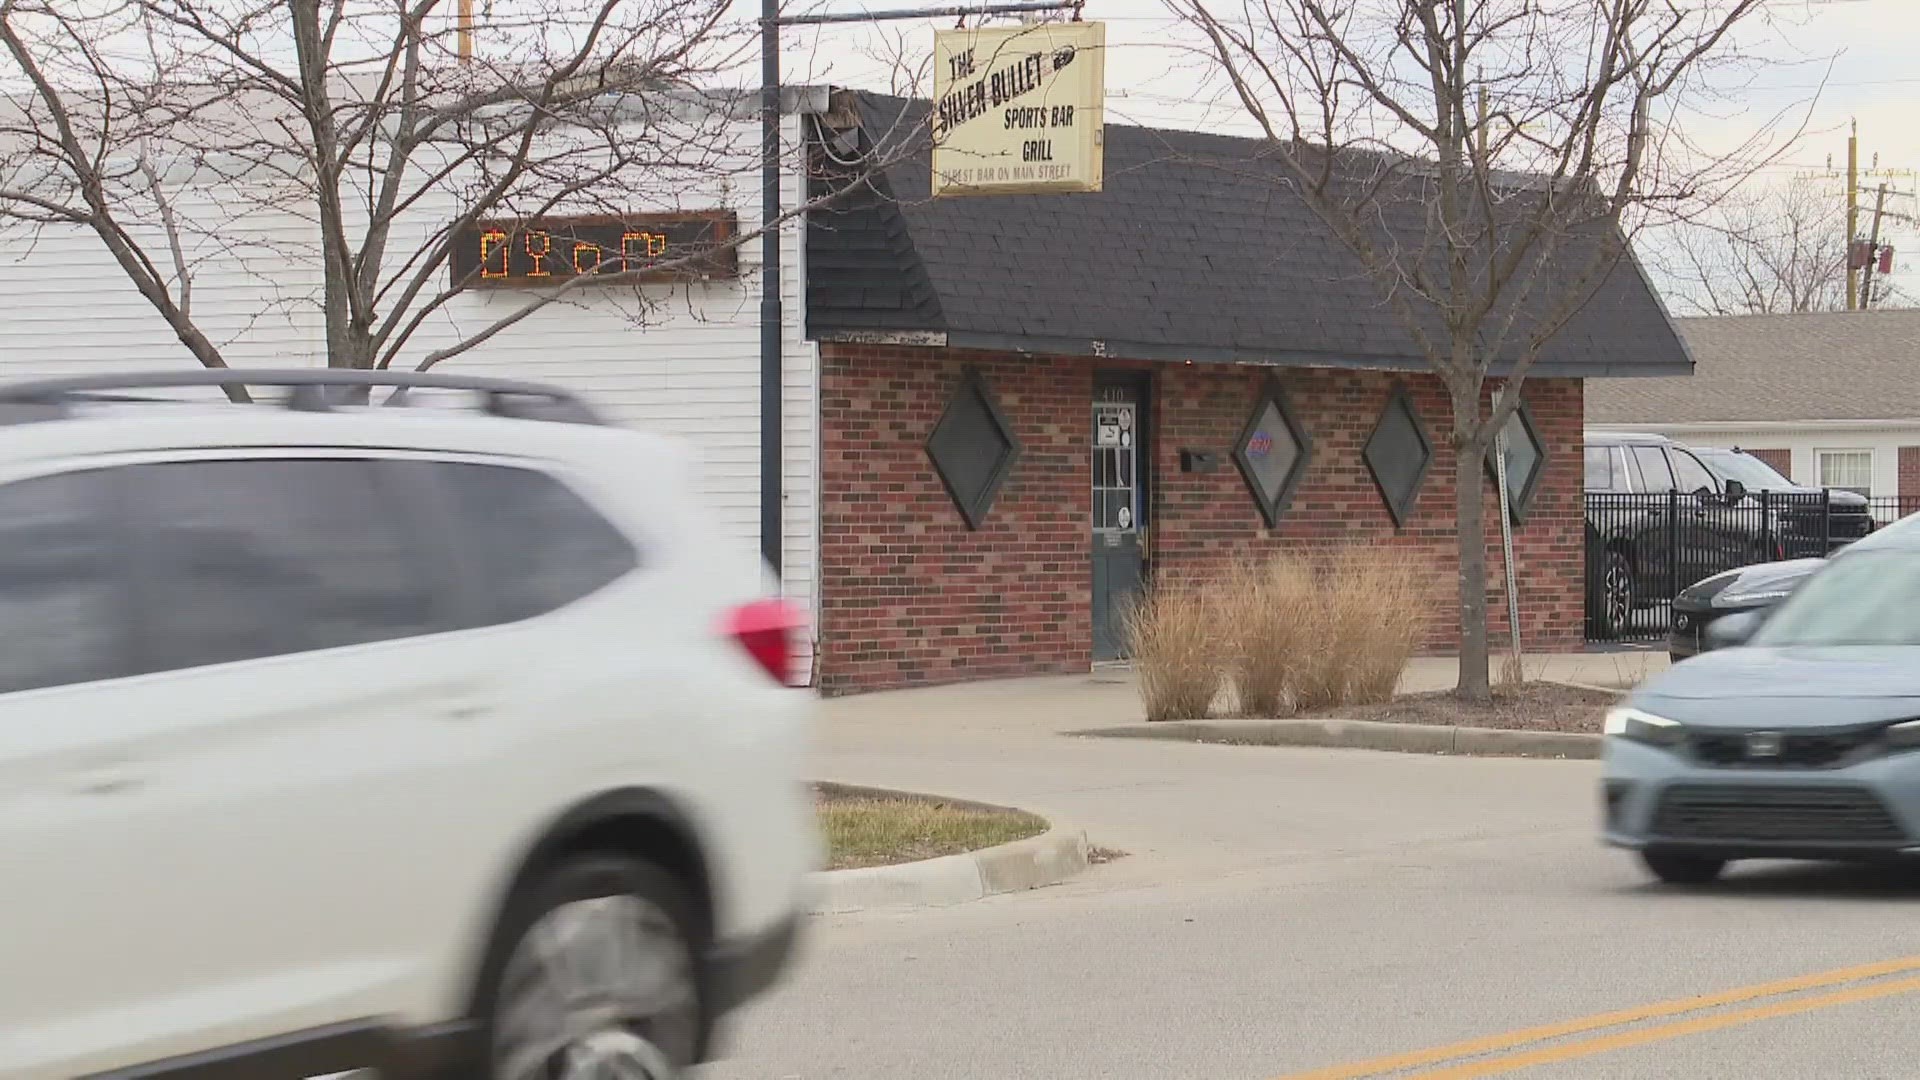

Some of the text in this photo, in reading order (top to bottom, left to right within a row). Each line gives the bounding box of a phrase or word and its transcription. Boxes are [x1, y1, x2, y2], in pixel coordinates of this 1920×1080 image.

[949, 48, 975, 80] THE
[938, 51, 1043, 133] SILVER BULLET
[1004, 105, 1074, 130] SPORTS BAR
[1022, 140, 1052, 162] GRILL
[977, 166, 994, 181] BAR
[997, 166, 1009, 180] ON
[1014, 165, 1037, 179] MAIN
[1038, 163, 1071, 180] STREET
[1103, 387, 1124, 401] 410
